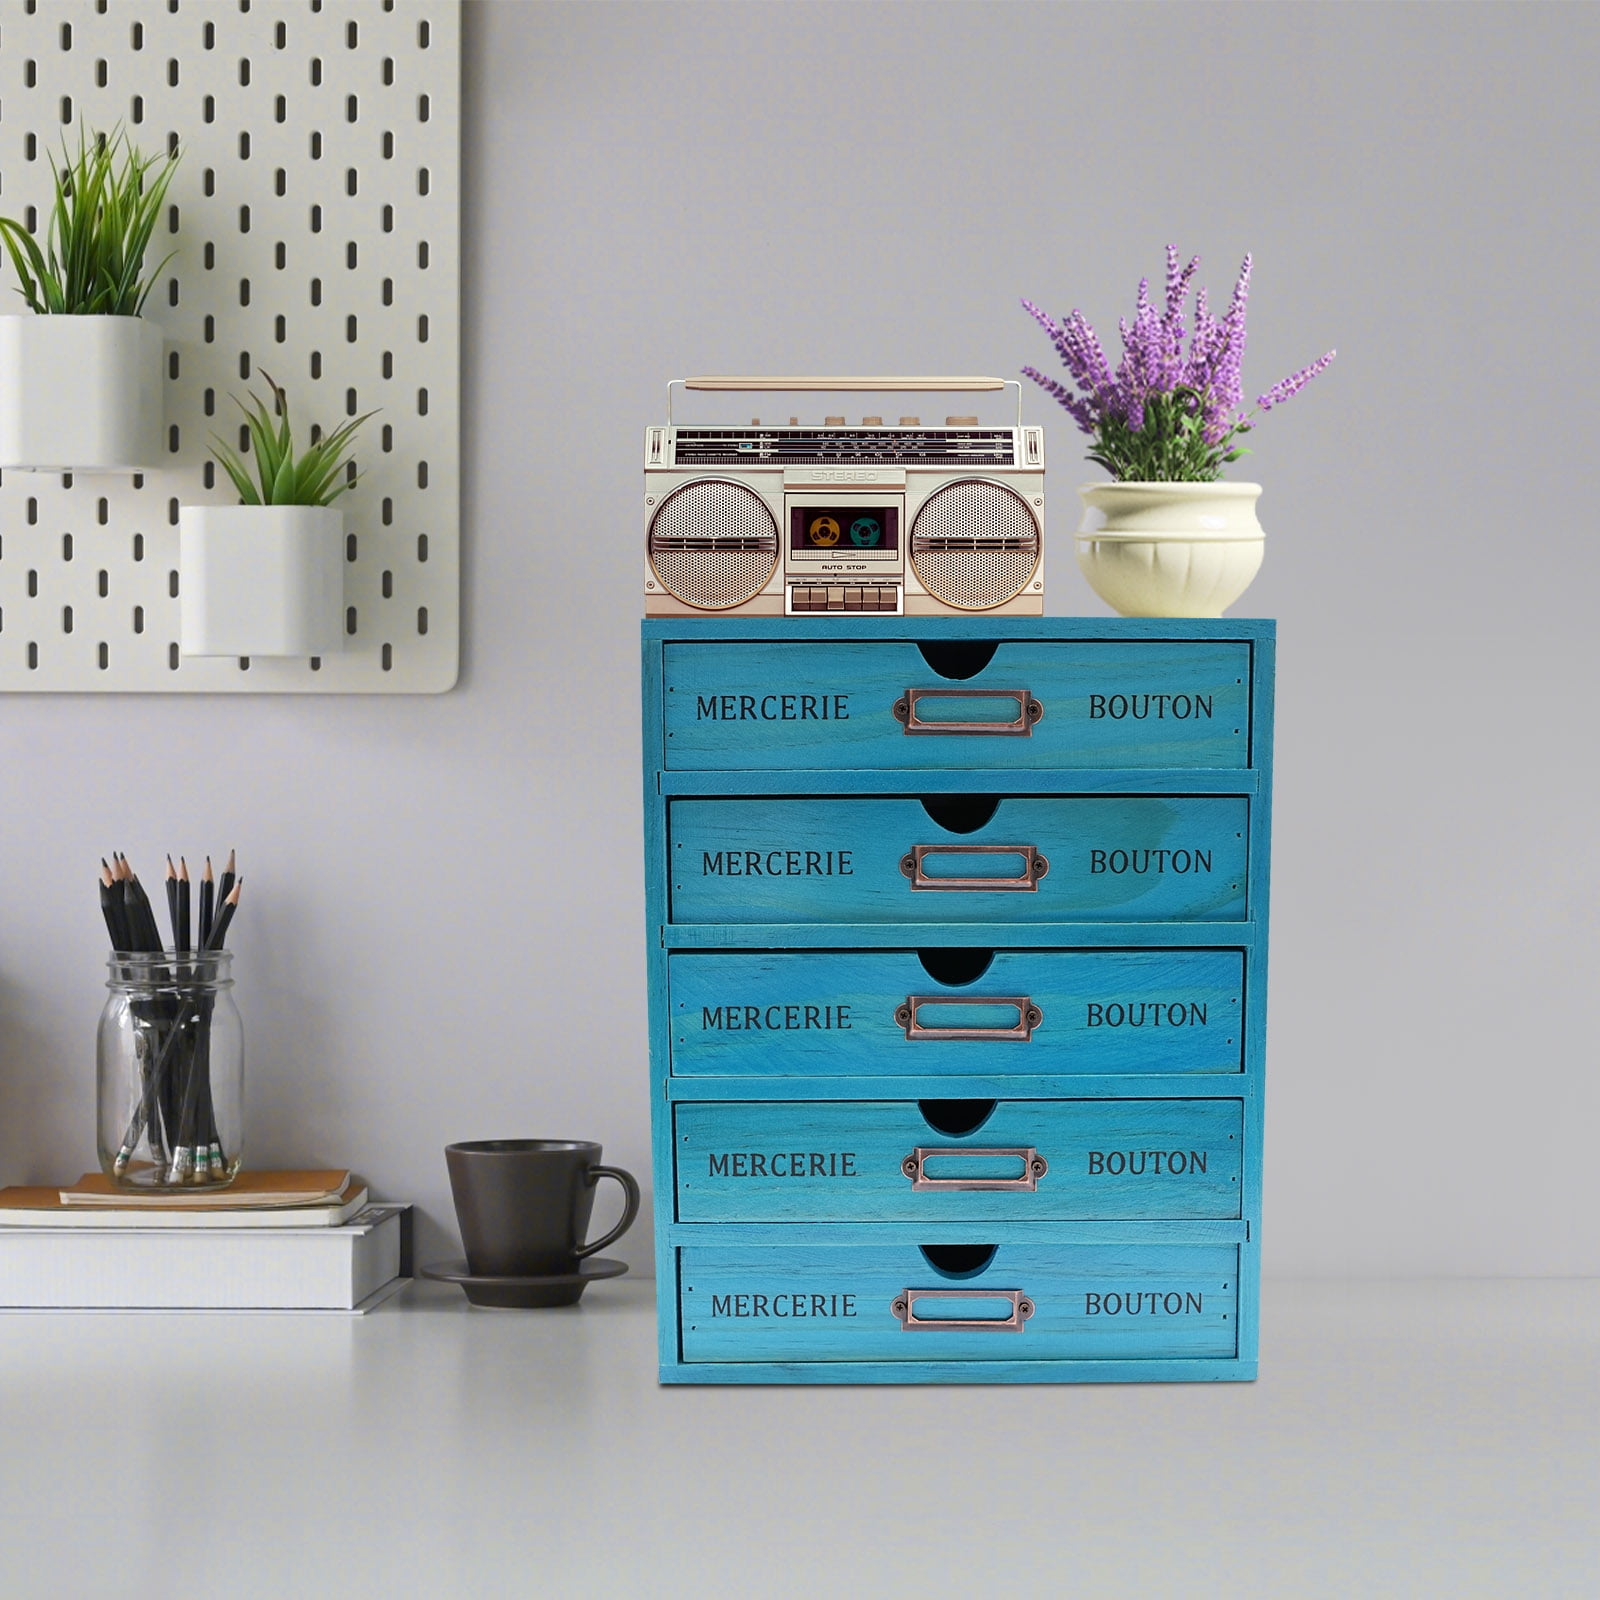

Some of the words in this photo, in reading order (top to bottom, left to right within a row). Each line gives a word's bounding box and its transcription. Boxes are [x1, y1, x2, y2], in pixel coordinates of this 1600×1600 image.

[811, 471, 879, 481] STEREO
[698, 695, 849, 720] MERCERIE
[1090, 695, 1212, 719] BOUTON
[704, 851, 853, 875] MERCERIE
[1091, 850, 1211, 874] BOUTON
[703, 1006, 851, 1030] MERCERIE
[1088, 1003, 1206, 1027] BOUTON
[710, 1153, 856, 1176] MERCERIE
[1089, 1152, 1206, 1175] BOUTON
[713, 1295, 857, 1317] MERCERIE
[1086, 1293, 1202, 1315] BOUTON
